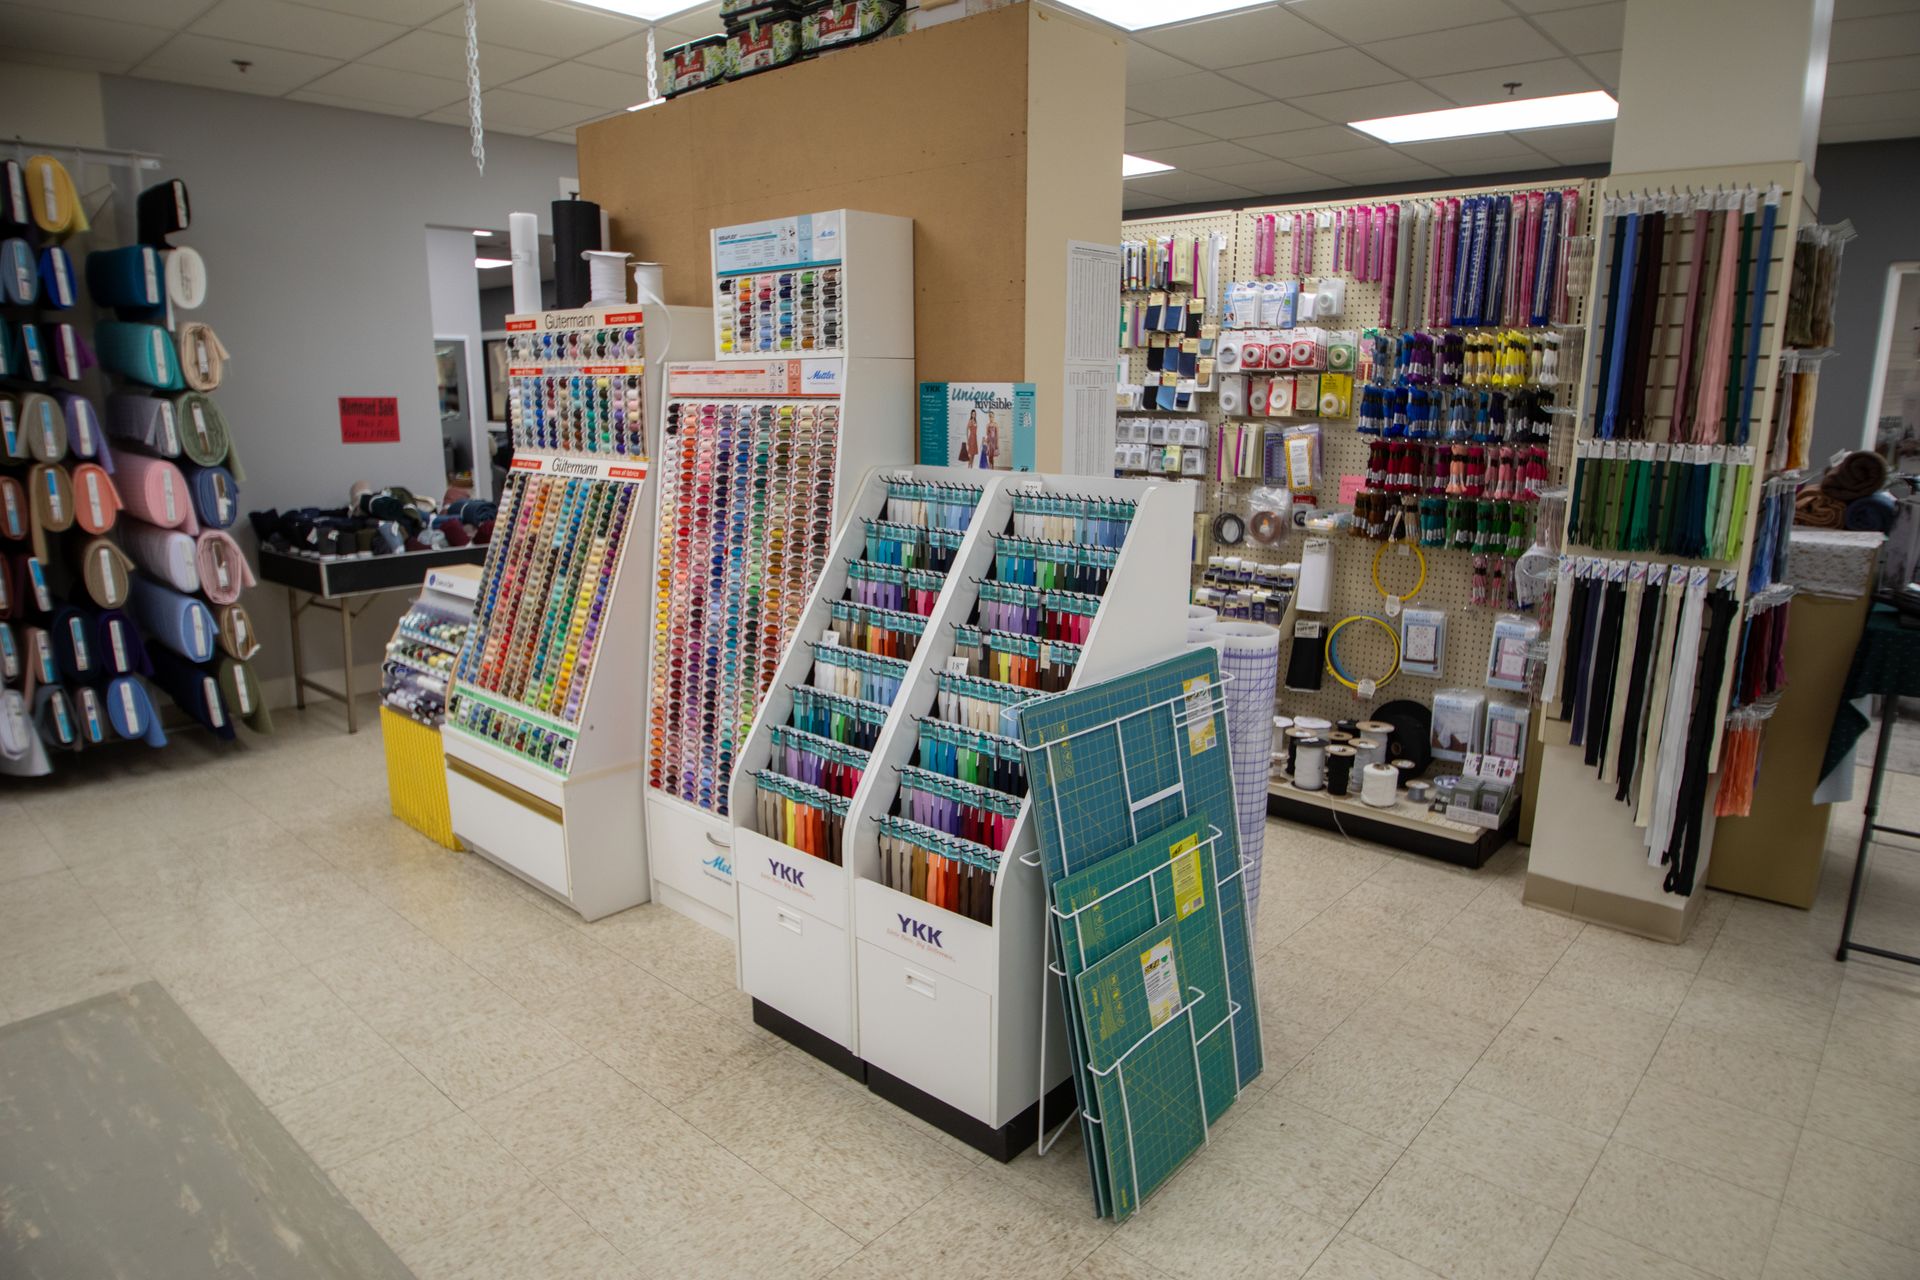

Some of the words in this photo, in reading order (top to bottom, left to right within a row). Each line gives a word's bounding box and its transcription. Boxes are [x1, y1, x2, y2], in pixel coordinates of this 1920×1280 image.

[789, 363, 800, 376] 50
[951, 387, 995, 403] Unique
[552, 457, 598, 476] Gütermann
[768, 857, 805, 889] YKK
[897, 912, 943, 949] YKK
